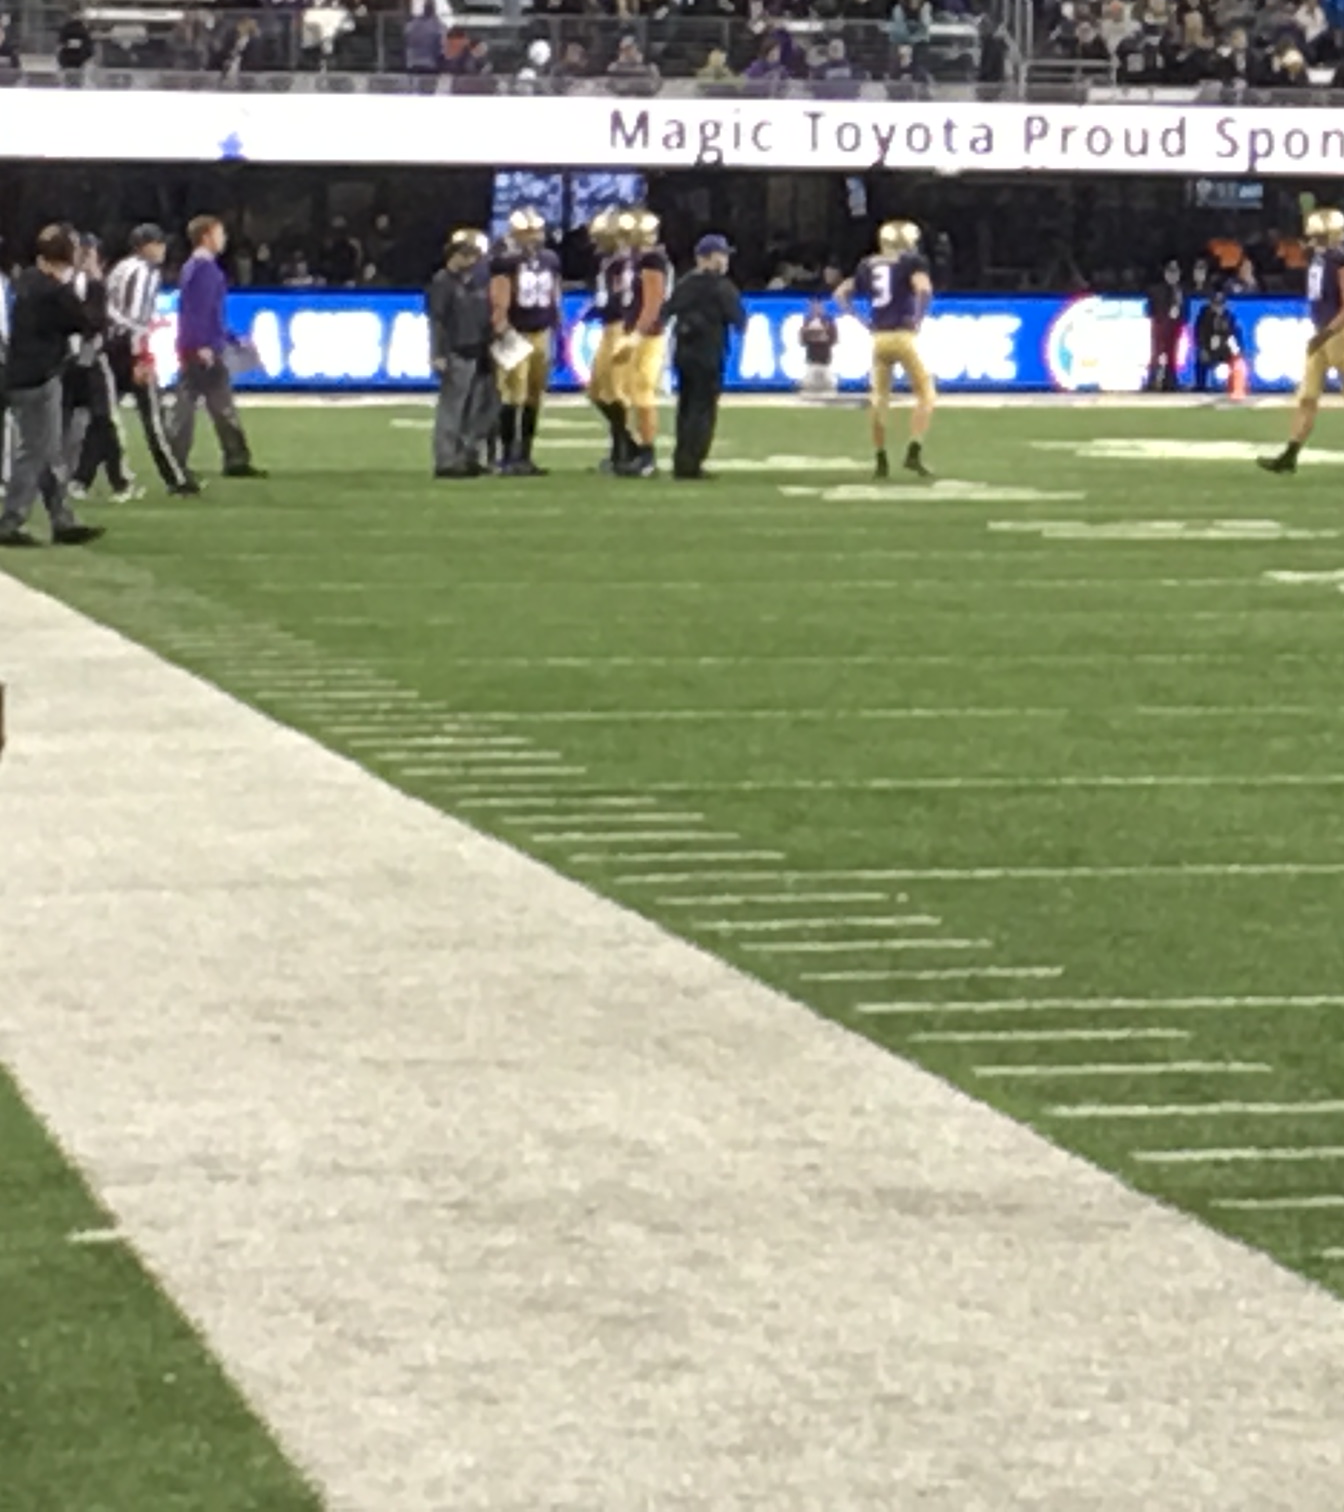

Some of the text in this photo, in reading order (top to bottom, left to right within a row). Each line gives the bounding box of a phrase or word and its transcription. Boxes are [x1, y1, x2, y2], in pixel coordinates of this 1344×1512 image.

[608, 107, 773, 165] Magic
[803, 111, 995, 165] Toyota
[1023, 115, 1186, 157] Proud
[871, 267, 891, 307] 3
